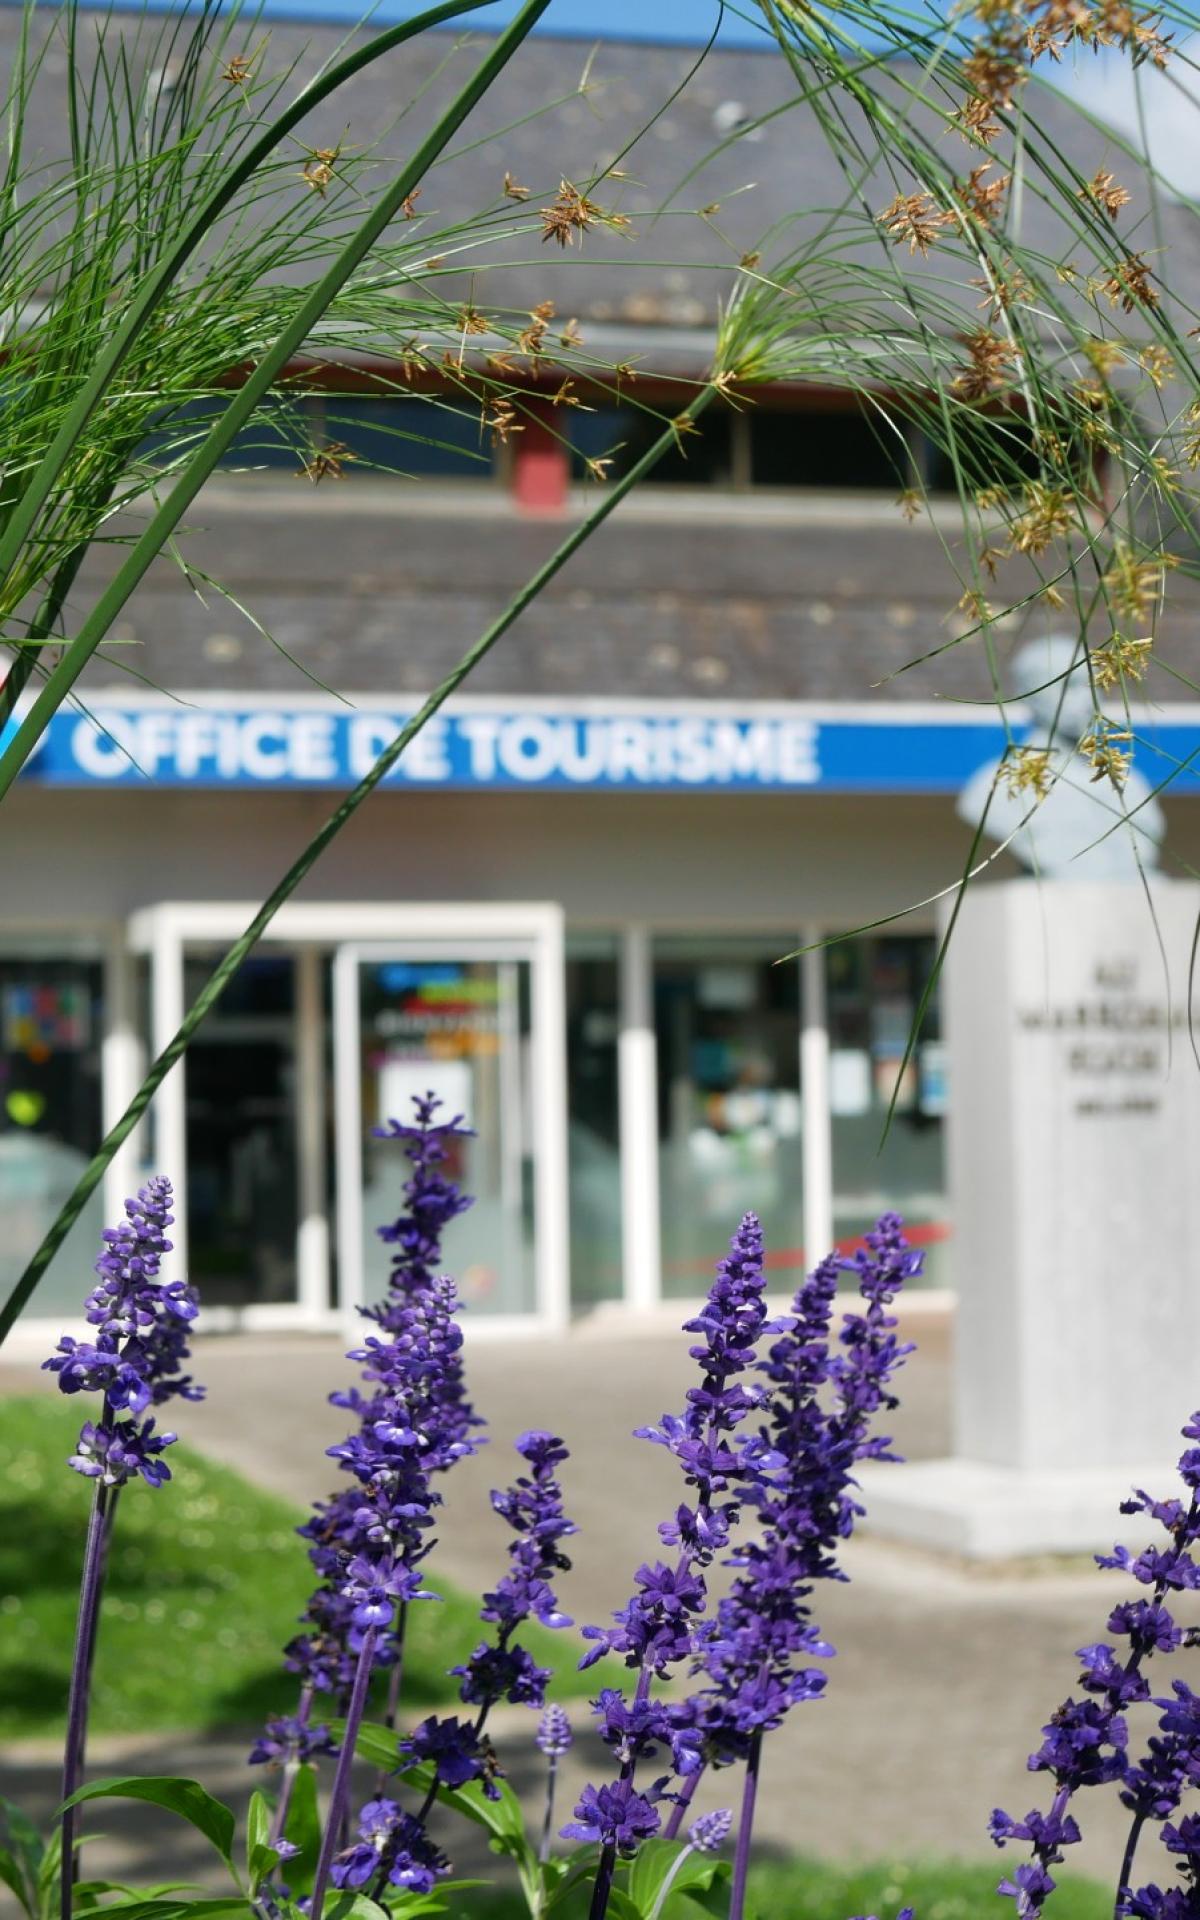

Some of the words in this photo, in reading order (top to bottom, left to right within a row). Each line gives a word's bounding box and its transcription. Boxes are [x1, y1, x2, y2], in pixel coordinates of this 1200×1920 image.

[72, 712, 337, 780] OFFICE
[348, 715, 450, 781] DE
[459, 717, 820, 784] TOURISME
